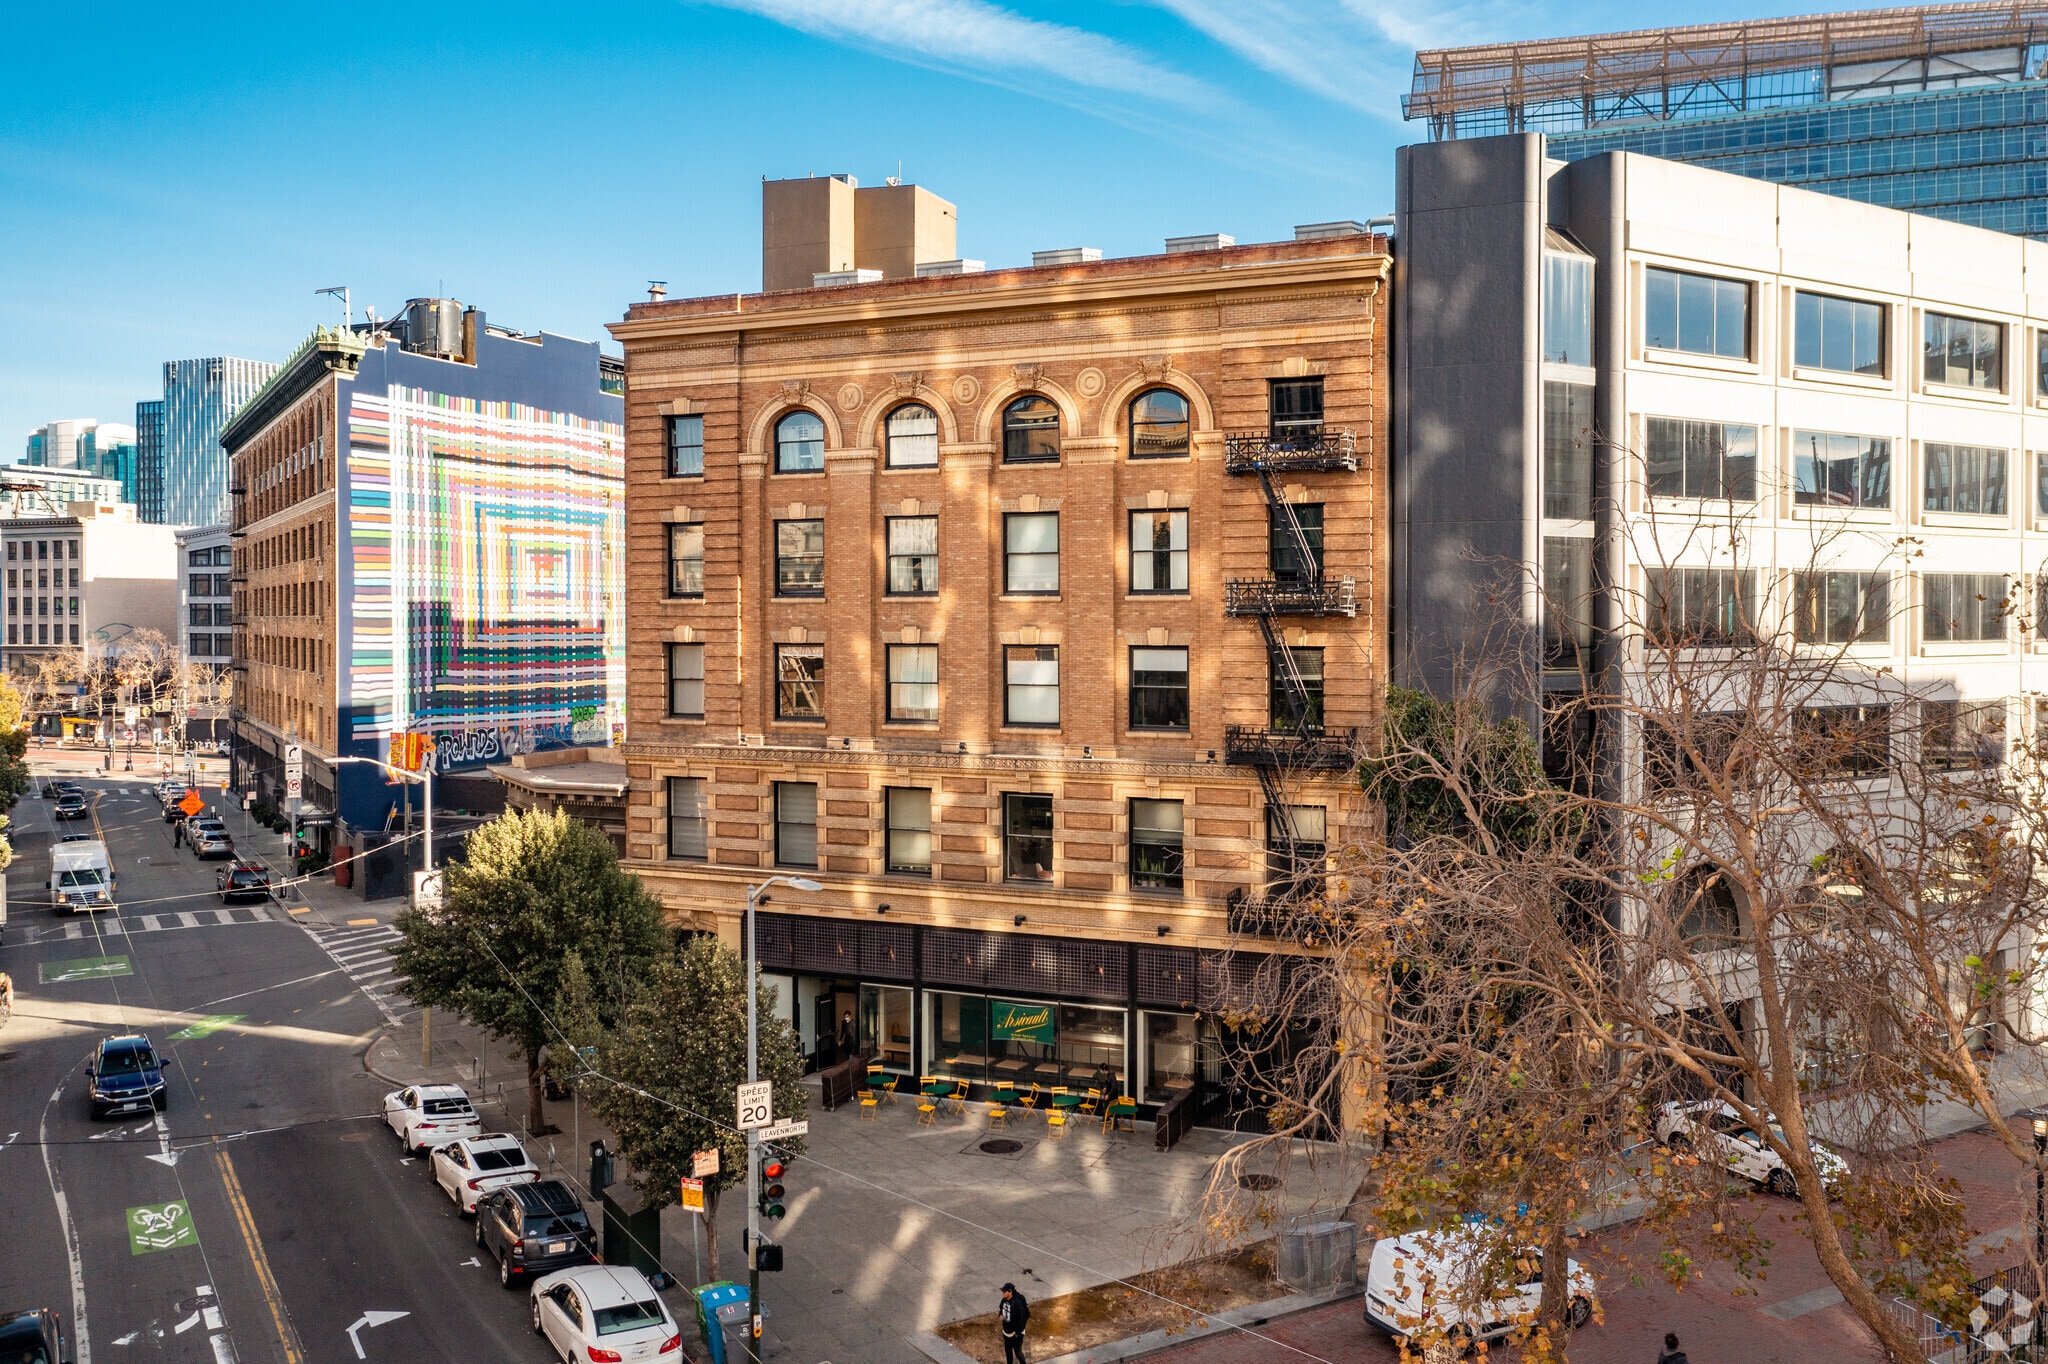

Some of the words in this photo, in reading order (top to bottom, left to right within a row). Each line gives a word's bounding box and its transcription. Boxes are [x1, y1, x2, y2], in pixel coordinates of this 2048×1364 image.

[1085, 375, 1096, 389] C
[962, 383, 971, 397] B
[997, 1007, 1049, 1030] Arsicault
[741, 1087, 768, 1097] SPEED
[743, 1096, 765, 1106] LIMIT
[742, 1105, 767, 1123] 20
[761, 1124, 806, 1138] LEAVENWORTH
